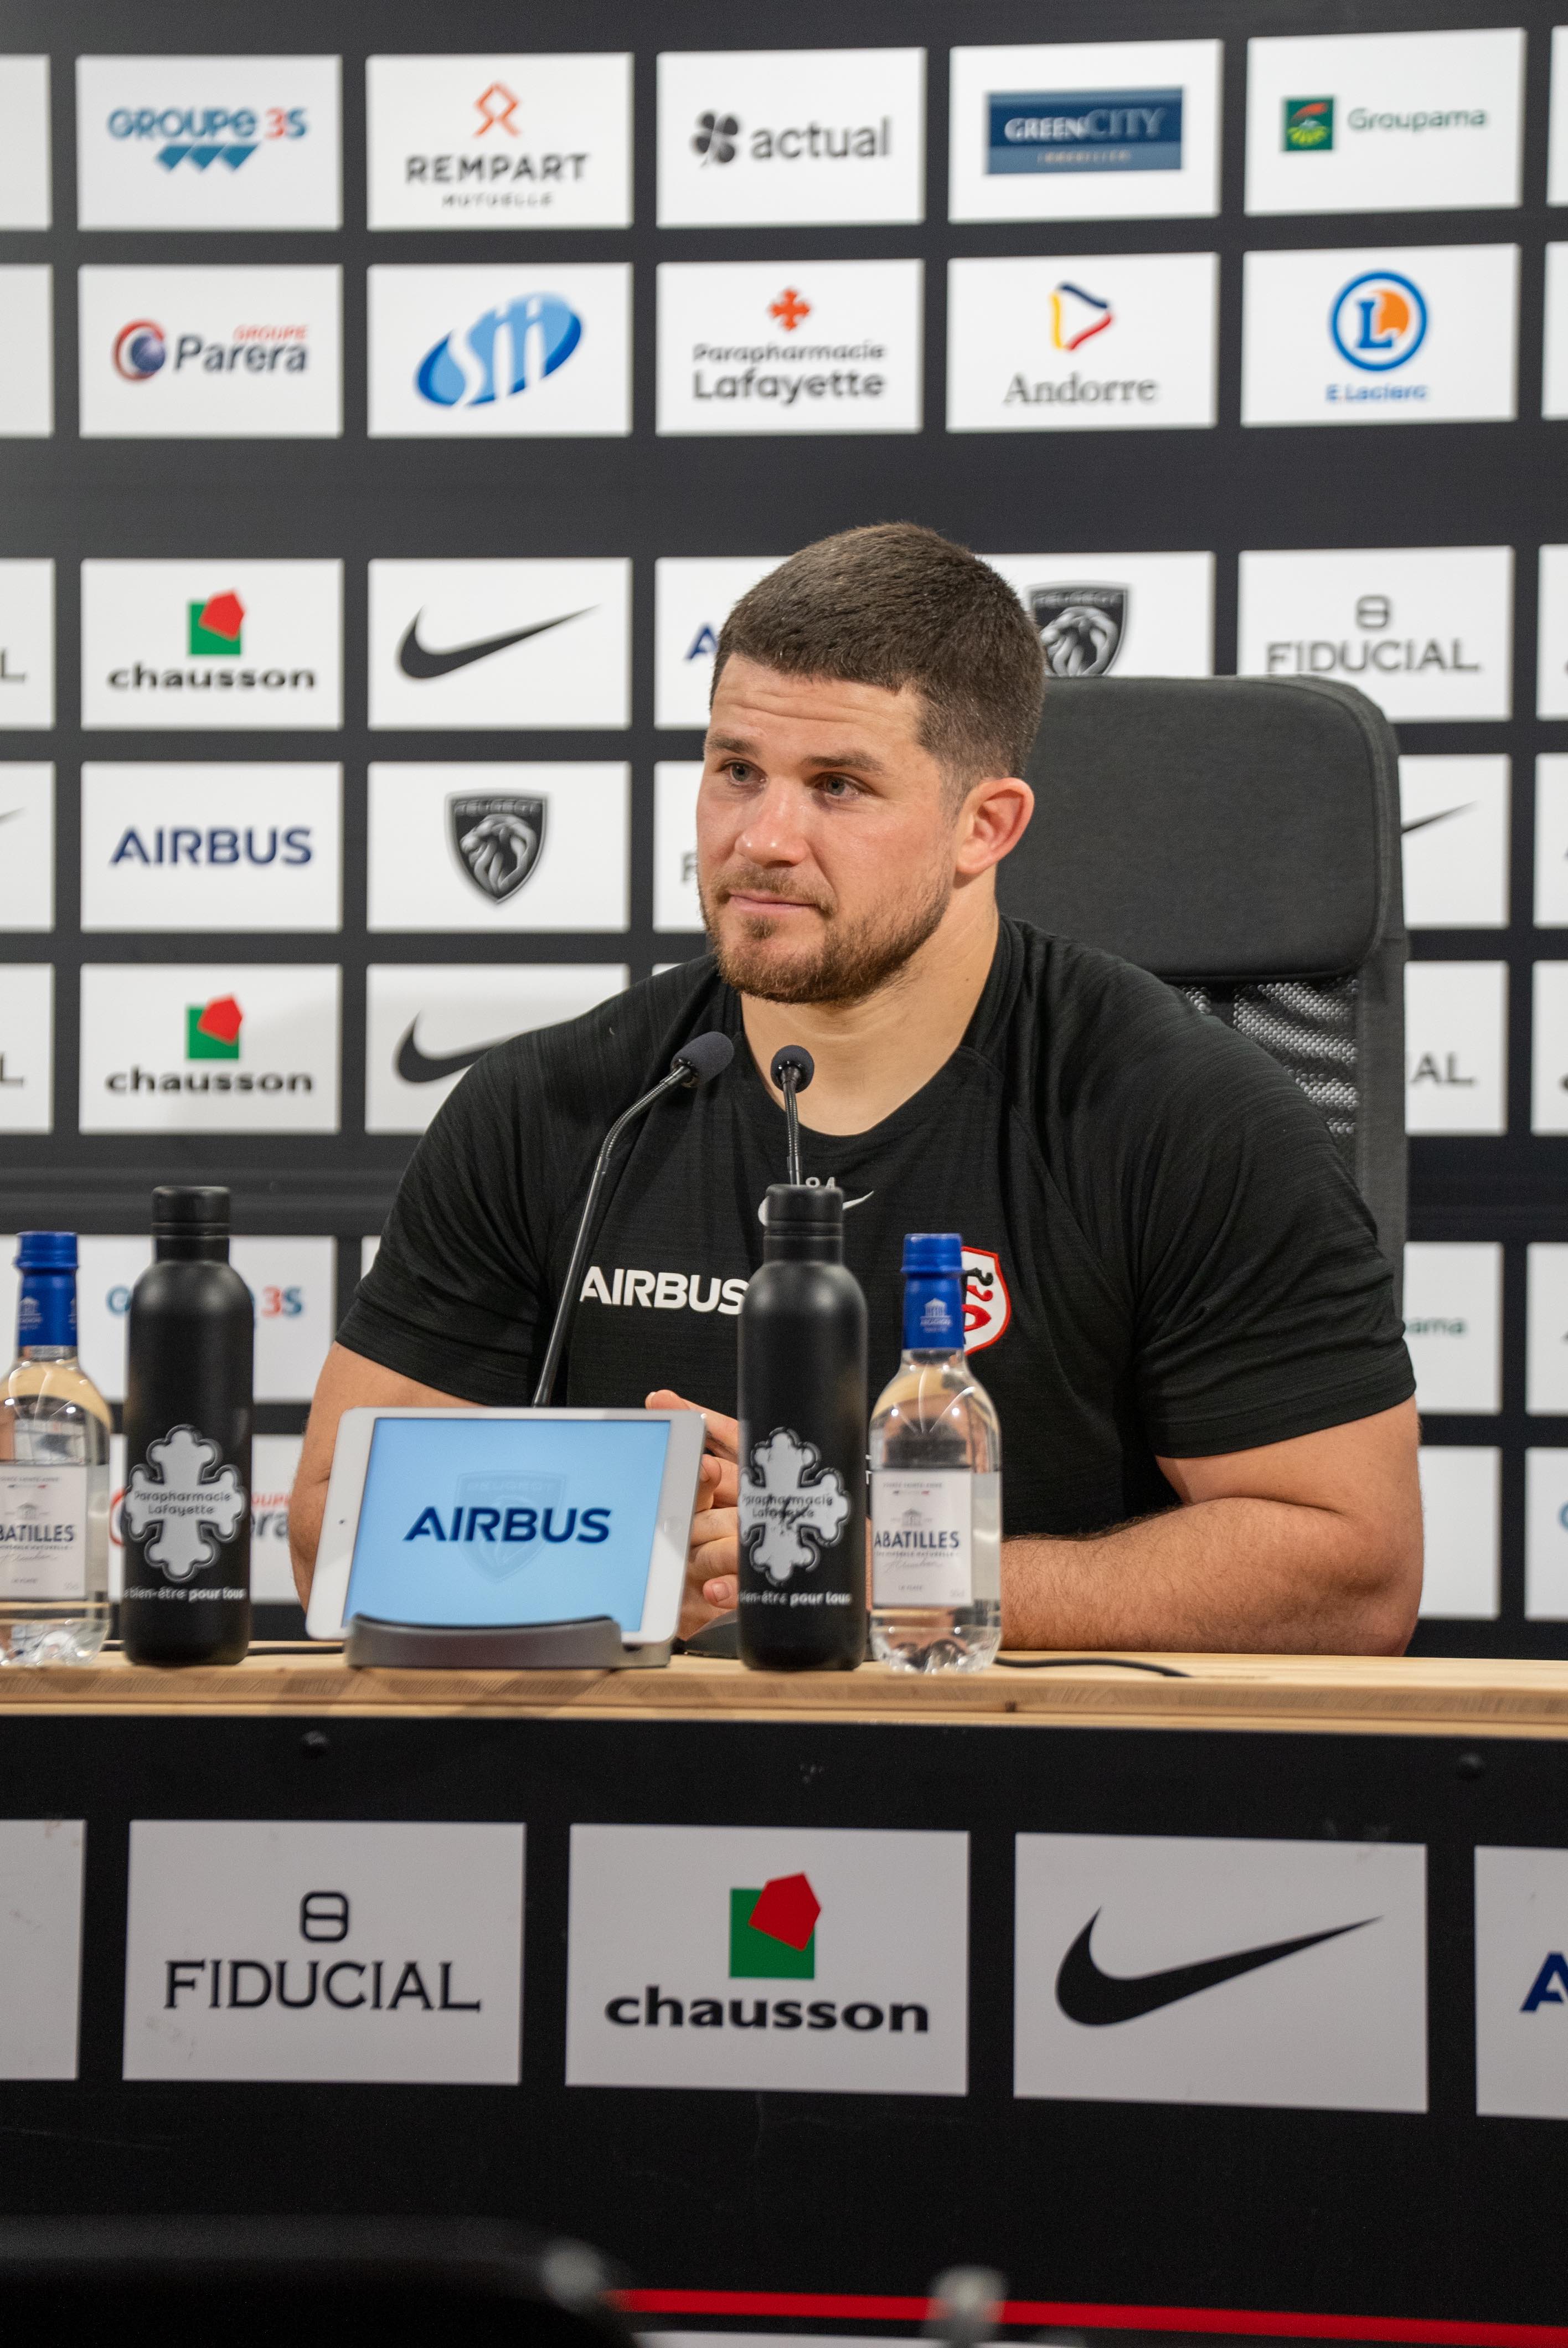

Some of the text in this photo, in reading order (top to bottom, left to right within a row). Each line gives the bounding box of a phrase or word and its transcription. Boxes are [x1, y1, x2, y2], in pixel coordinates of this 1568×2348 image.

[265, 107, 308, 140] 3S
[1347, 107, 1489, 133] Groupama
[750, 116, 891, 161] actual
[406, 153, 589, 184] REMPART
[441, 192, 553, 208] MUTUELLE
[233, 325, 308, 341] GROUPE
[173, 334, 308, 373] Parera
[693, 342, 886, 366] Parapharmacie
[693, 368, 886, 407] Lafayette
[1003, 370, 1159, 406] Andorre
[1267, 637, 1482, 674] FIDUCIAL
[107, 661, 316, 690] chausson
[109, 826, 313, 867] AIRBUS
[105, 1066, 314, 1095] chausson
[580, 1265, 750, 1316] AIRBUS
[135, 1491, 231, 1503] Parapharmacie
[148, 1504, 215, 1517] Lafayette
[403, 1506, 612, 1544] AIRBUS
[874, 1530, 960, 1549] ABATILLES
[188, 1588, 221, 1602] pour
[223, 1587, 246, 1600] tous
[790, 1592, 824, 1608] pour
[826, 1590, 853, 1605] tous
[164, 1959, 482, 2013] FIDUCIAL
[604, 1985, 930, 2033] chausson
